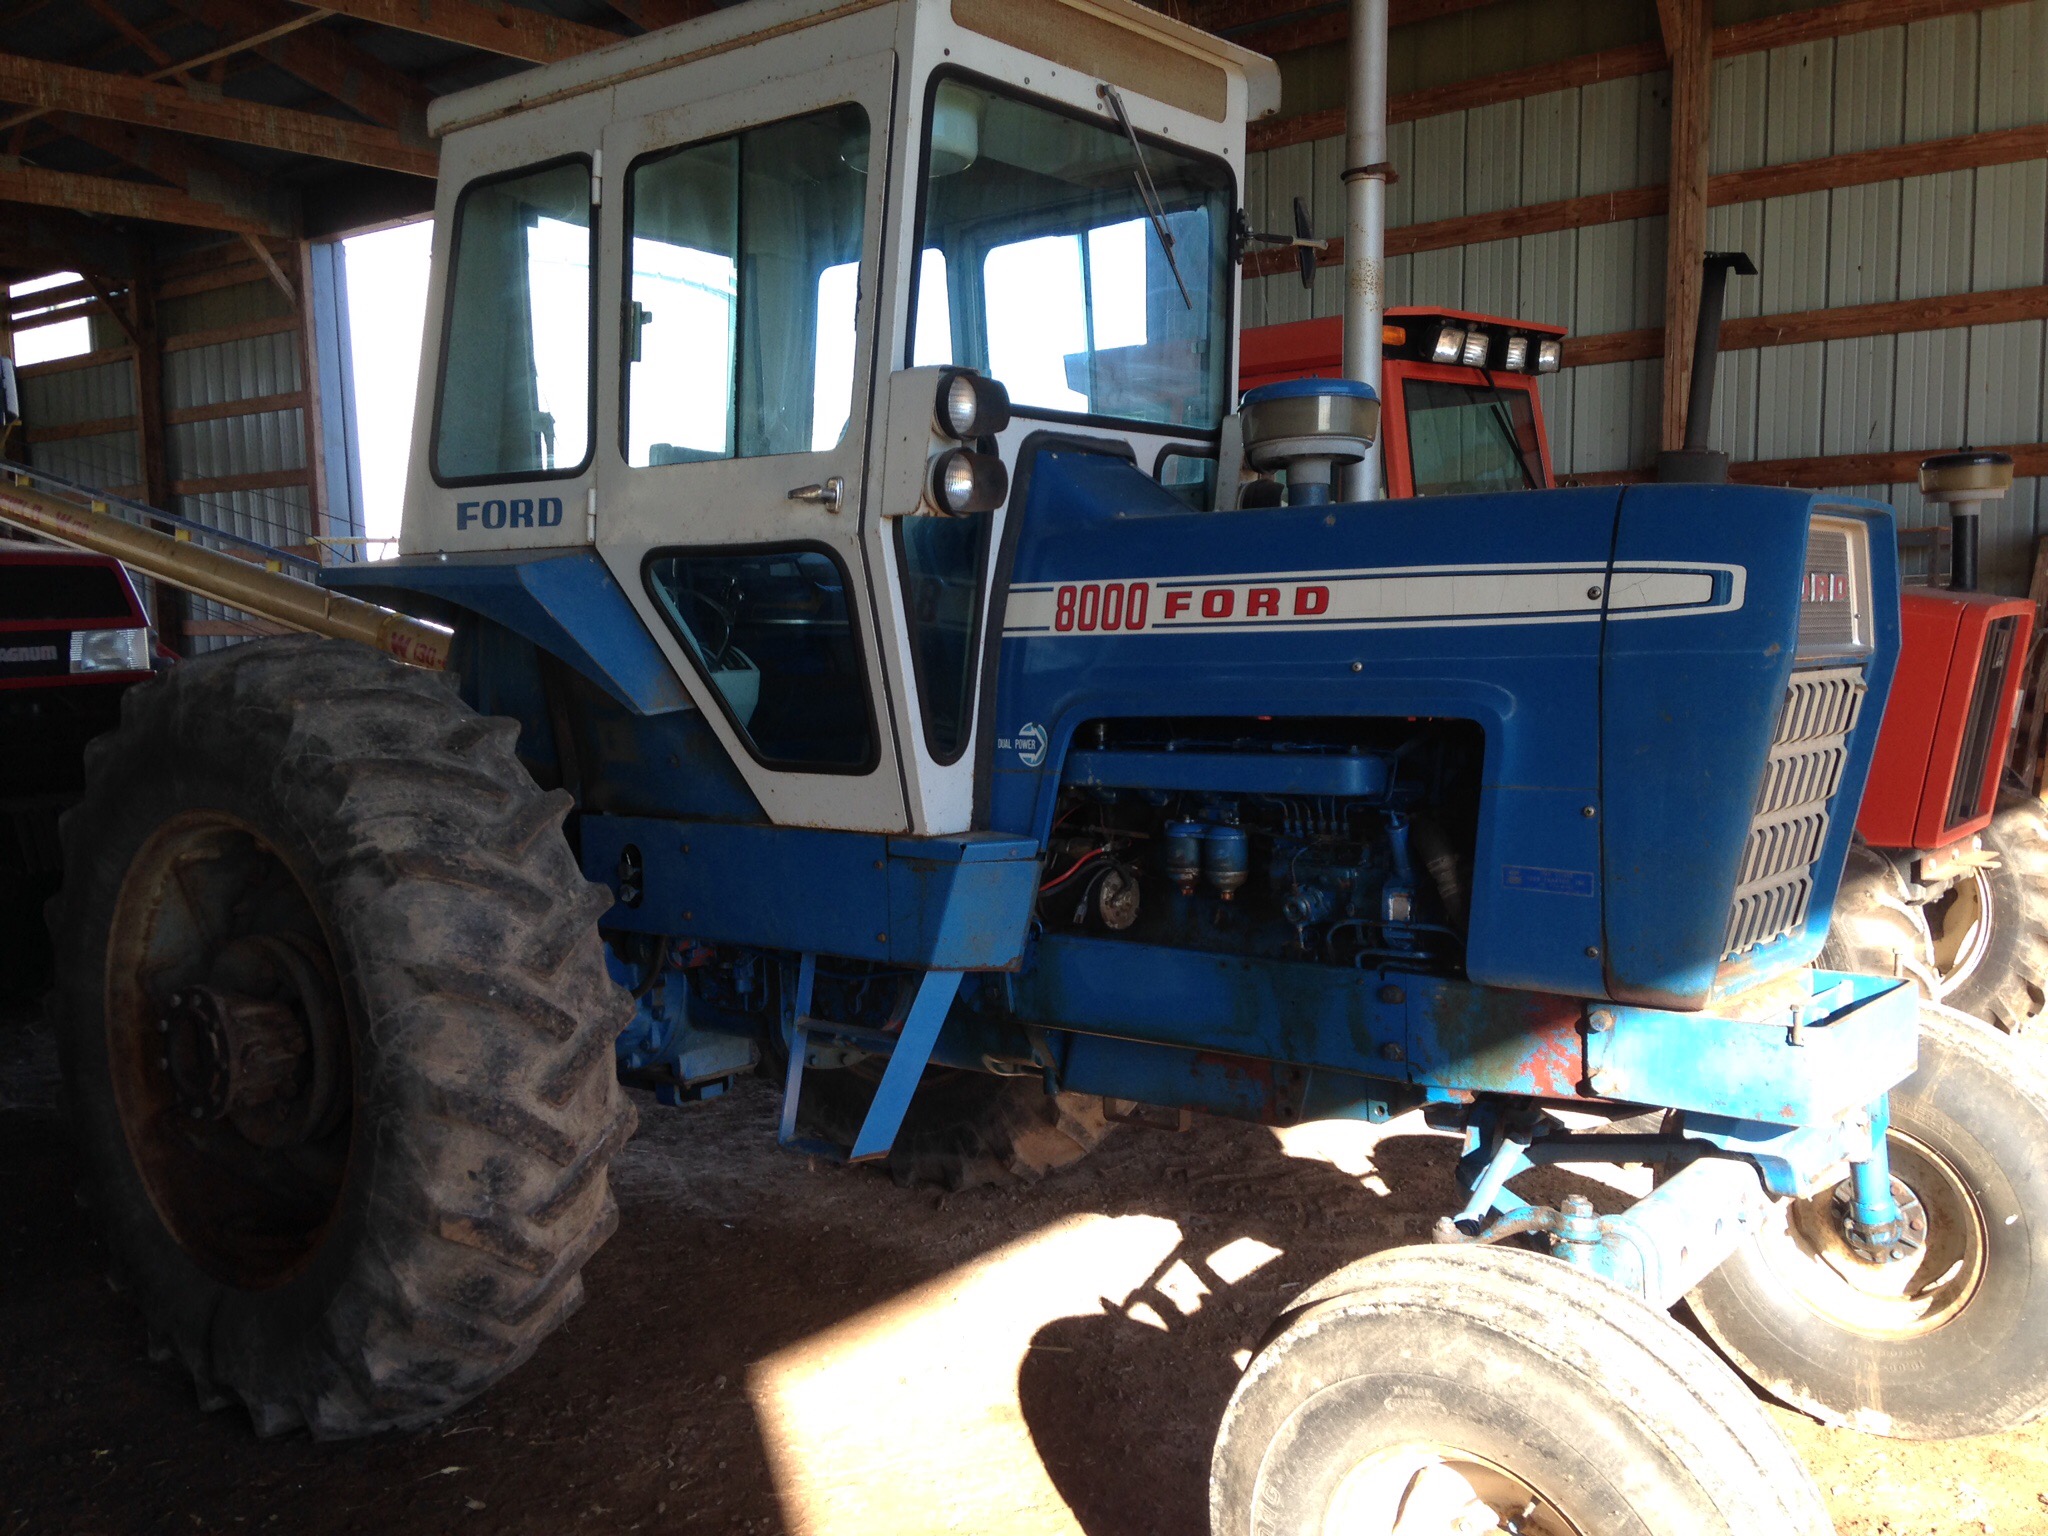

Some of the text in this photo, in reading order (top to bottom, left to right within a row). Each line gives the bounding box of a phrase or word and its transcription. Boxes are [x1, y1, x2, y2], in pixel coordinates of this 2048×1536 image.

[457, 497, 562, 531] FORD
[1801, 573, 1848, 602] ORD
[1054, 581, 1330, 631] 8000 FORD
[0, 645, 58, 662] AGNUM
[997, 738, 1036, 750] DUAL POWER
